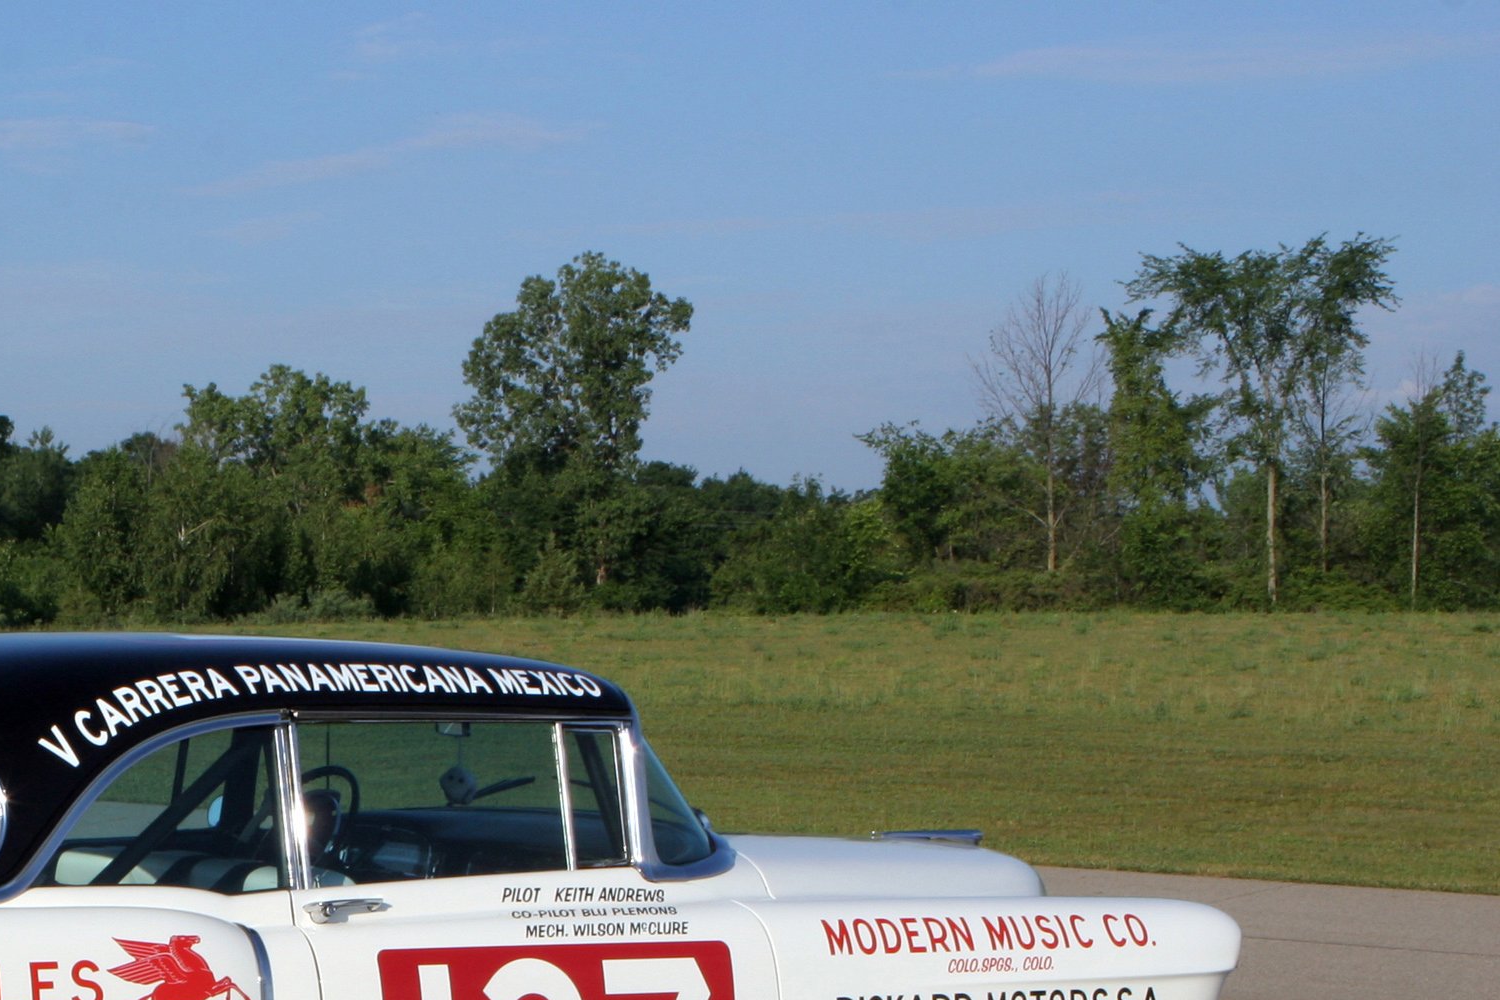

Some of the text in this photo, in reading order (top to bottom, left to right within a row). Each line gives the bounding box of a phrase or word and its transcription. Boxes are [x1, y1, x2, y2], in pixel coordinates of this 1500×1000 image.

[38, 664, 601, 768] V CARRERA PANAMERICANA MEXICO
[501, 887, 665, 903] PILOT KEITH ANDREWS
[511, 906, 678, 919] CO-PILOT BLU PLEMONS
[525, 924, 568, 938] MECH.
[573, 923, 624, 936] WILSON
[821, 913, 1157, 956] MODERN MUSIC CO.
[1022, 955, 1054, 971] COLO.
